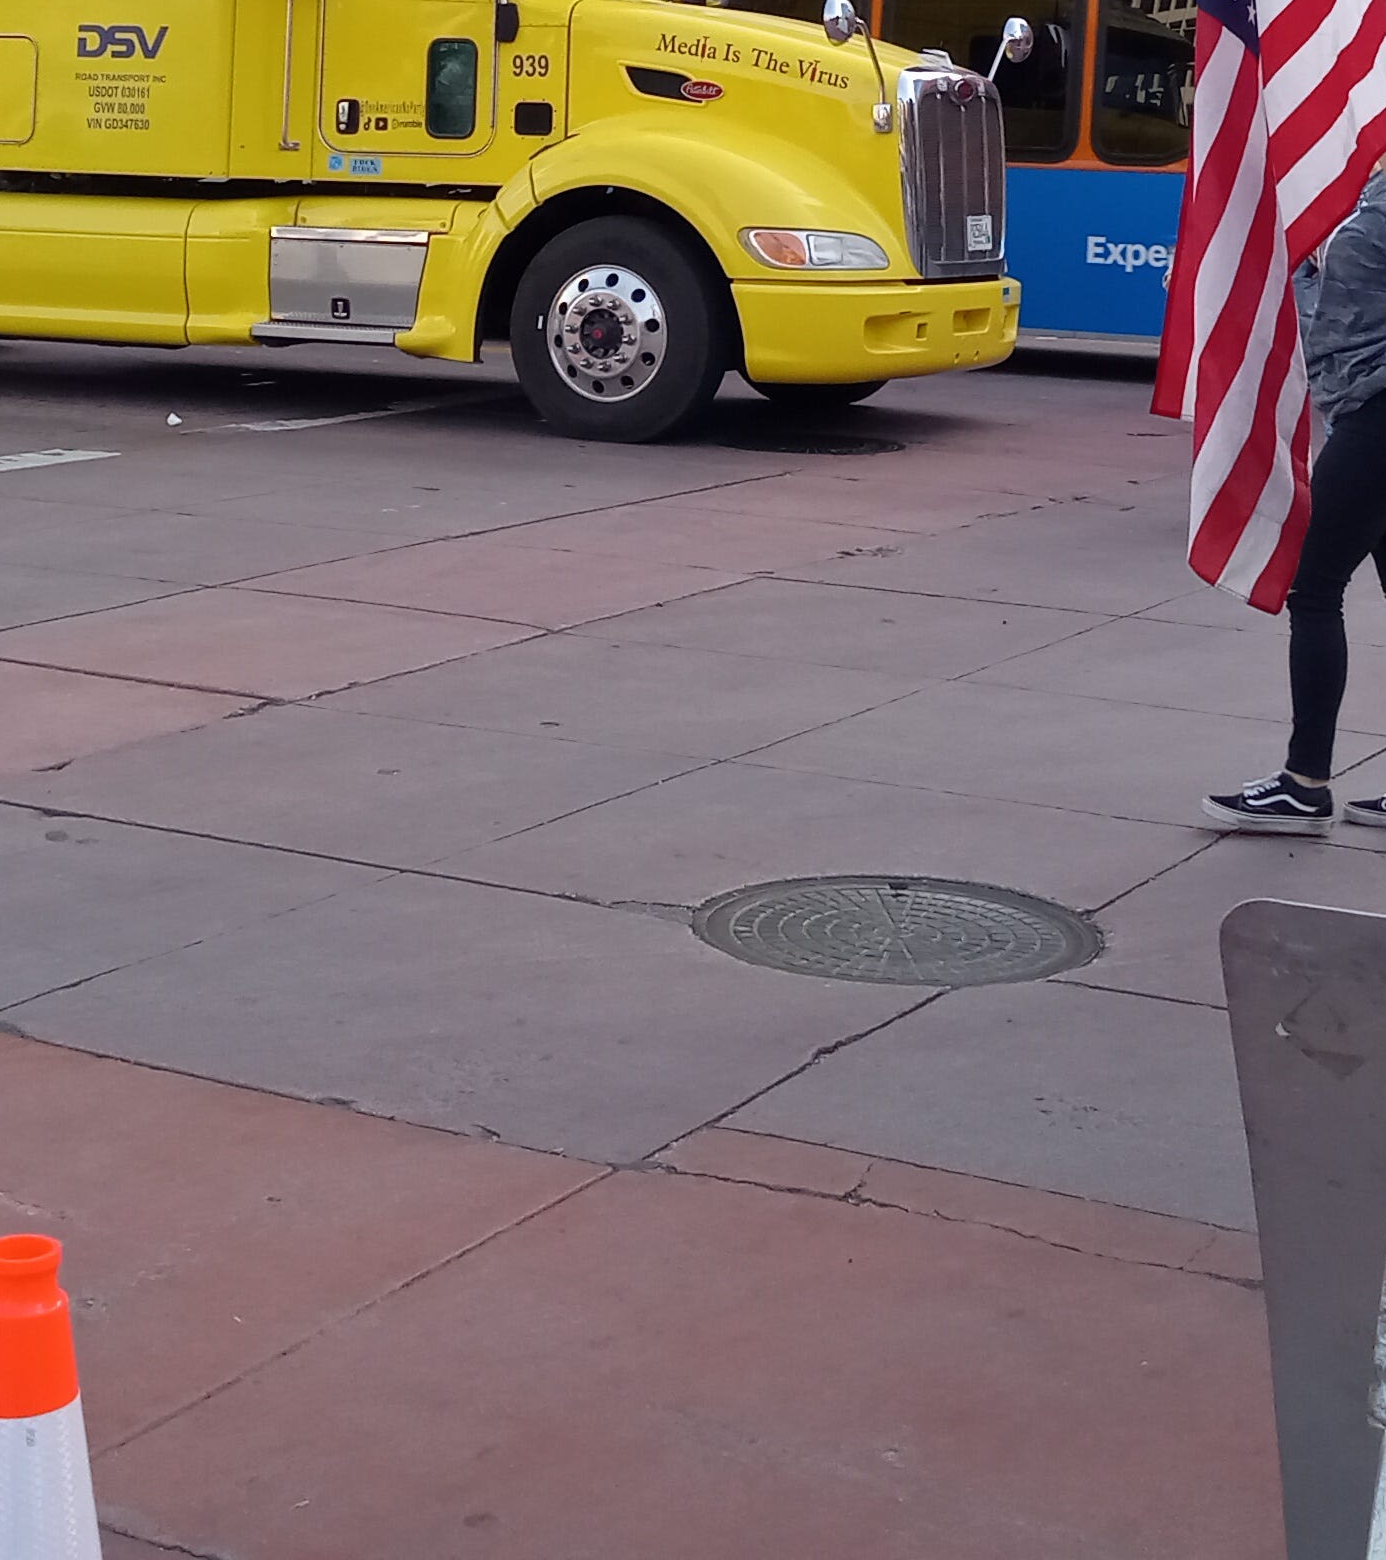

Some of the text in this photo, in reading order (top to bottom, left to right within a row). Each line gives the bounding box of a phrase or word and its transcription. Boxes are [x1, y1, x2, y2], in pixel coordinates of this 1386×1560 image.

[77, 24, 169, 59] DSV
[512, 54, 549, 78] 939
[723, 43, 741, 63] Is
[751, 48, 790, 74] The
[75, 72, 167, 83] ROAD TRANSPORT INC
[88, 85, 119, 98] USDOT
[93, 101, 116, 114] GVW
[86, 118, 102, 129] VIN
[1086, 236, 1168, 273] Expe
